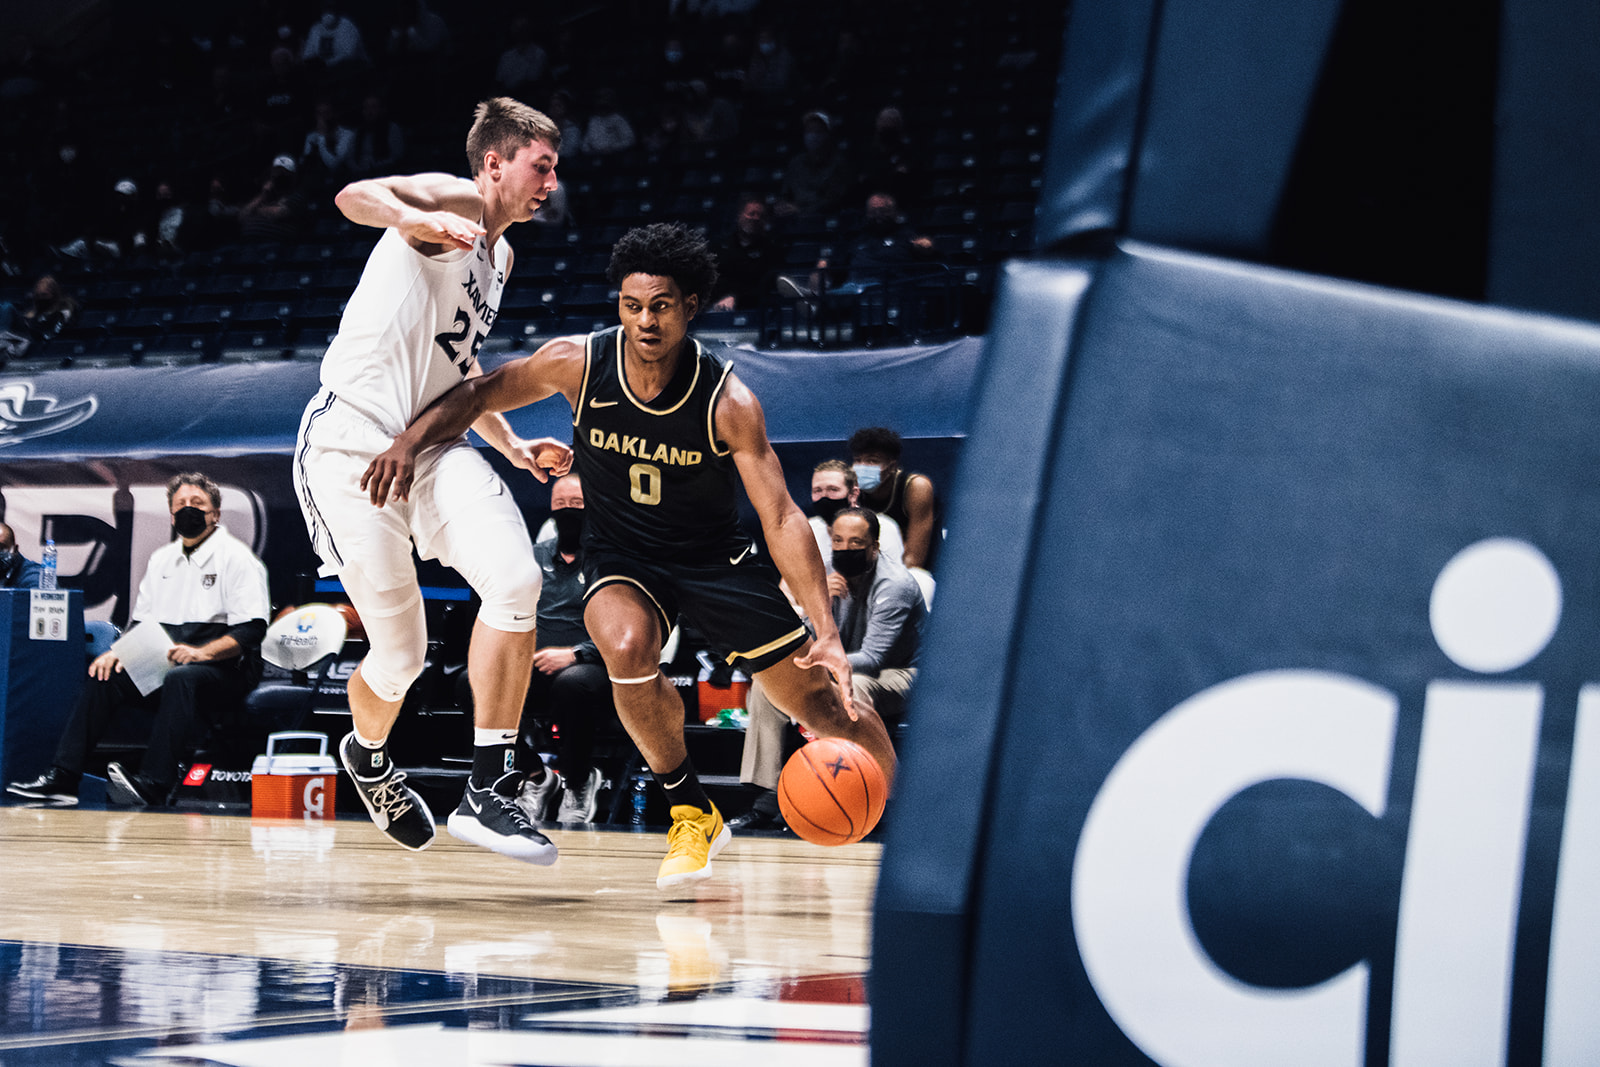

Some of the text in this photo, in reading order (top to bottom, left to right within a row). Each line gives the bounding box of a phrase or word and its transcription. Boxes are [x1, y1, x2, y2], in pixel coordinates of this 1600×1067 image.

[461, 269, 498, 327] XAVIE
[590, 428, 702, 467] OAKLAND
[629, 463, 662, 506] 0
[280, 634, 319, 646] TriHealth
[303, 777, 325, 814] G
